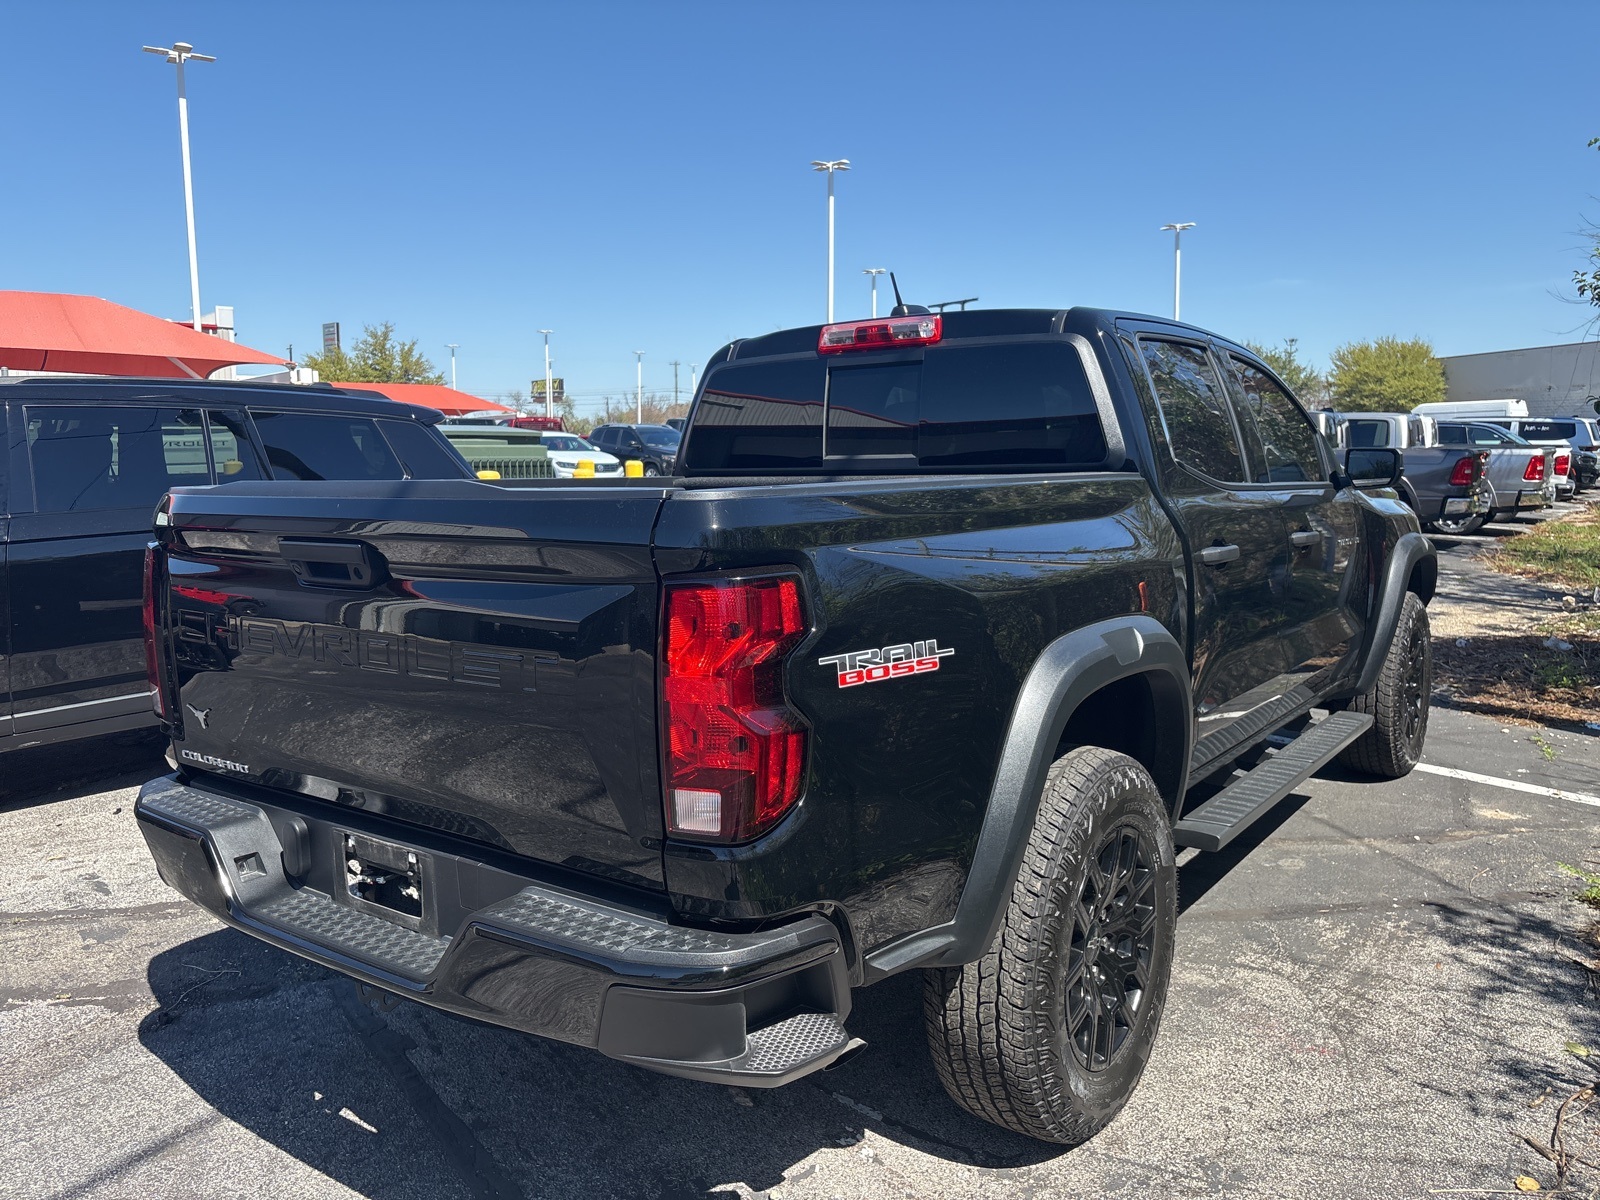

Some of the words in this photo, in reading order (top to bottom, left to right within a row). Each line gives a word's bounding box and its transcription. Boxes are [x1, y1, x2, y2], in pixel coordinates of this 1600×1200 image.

[178, 608, 560, 692] CHEVROLET
[818, 639, 955, 673] TRAIL
[838, 656, 940, 689] BOSS
[181, 749, 249, 774] COLORADO
